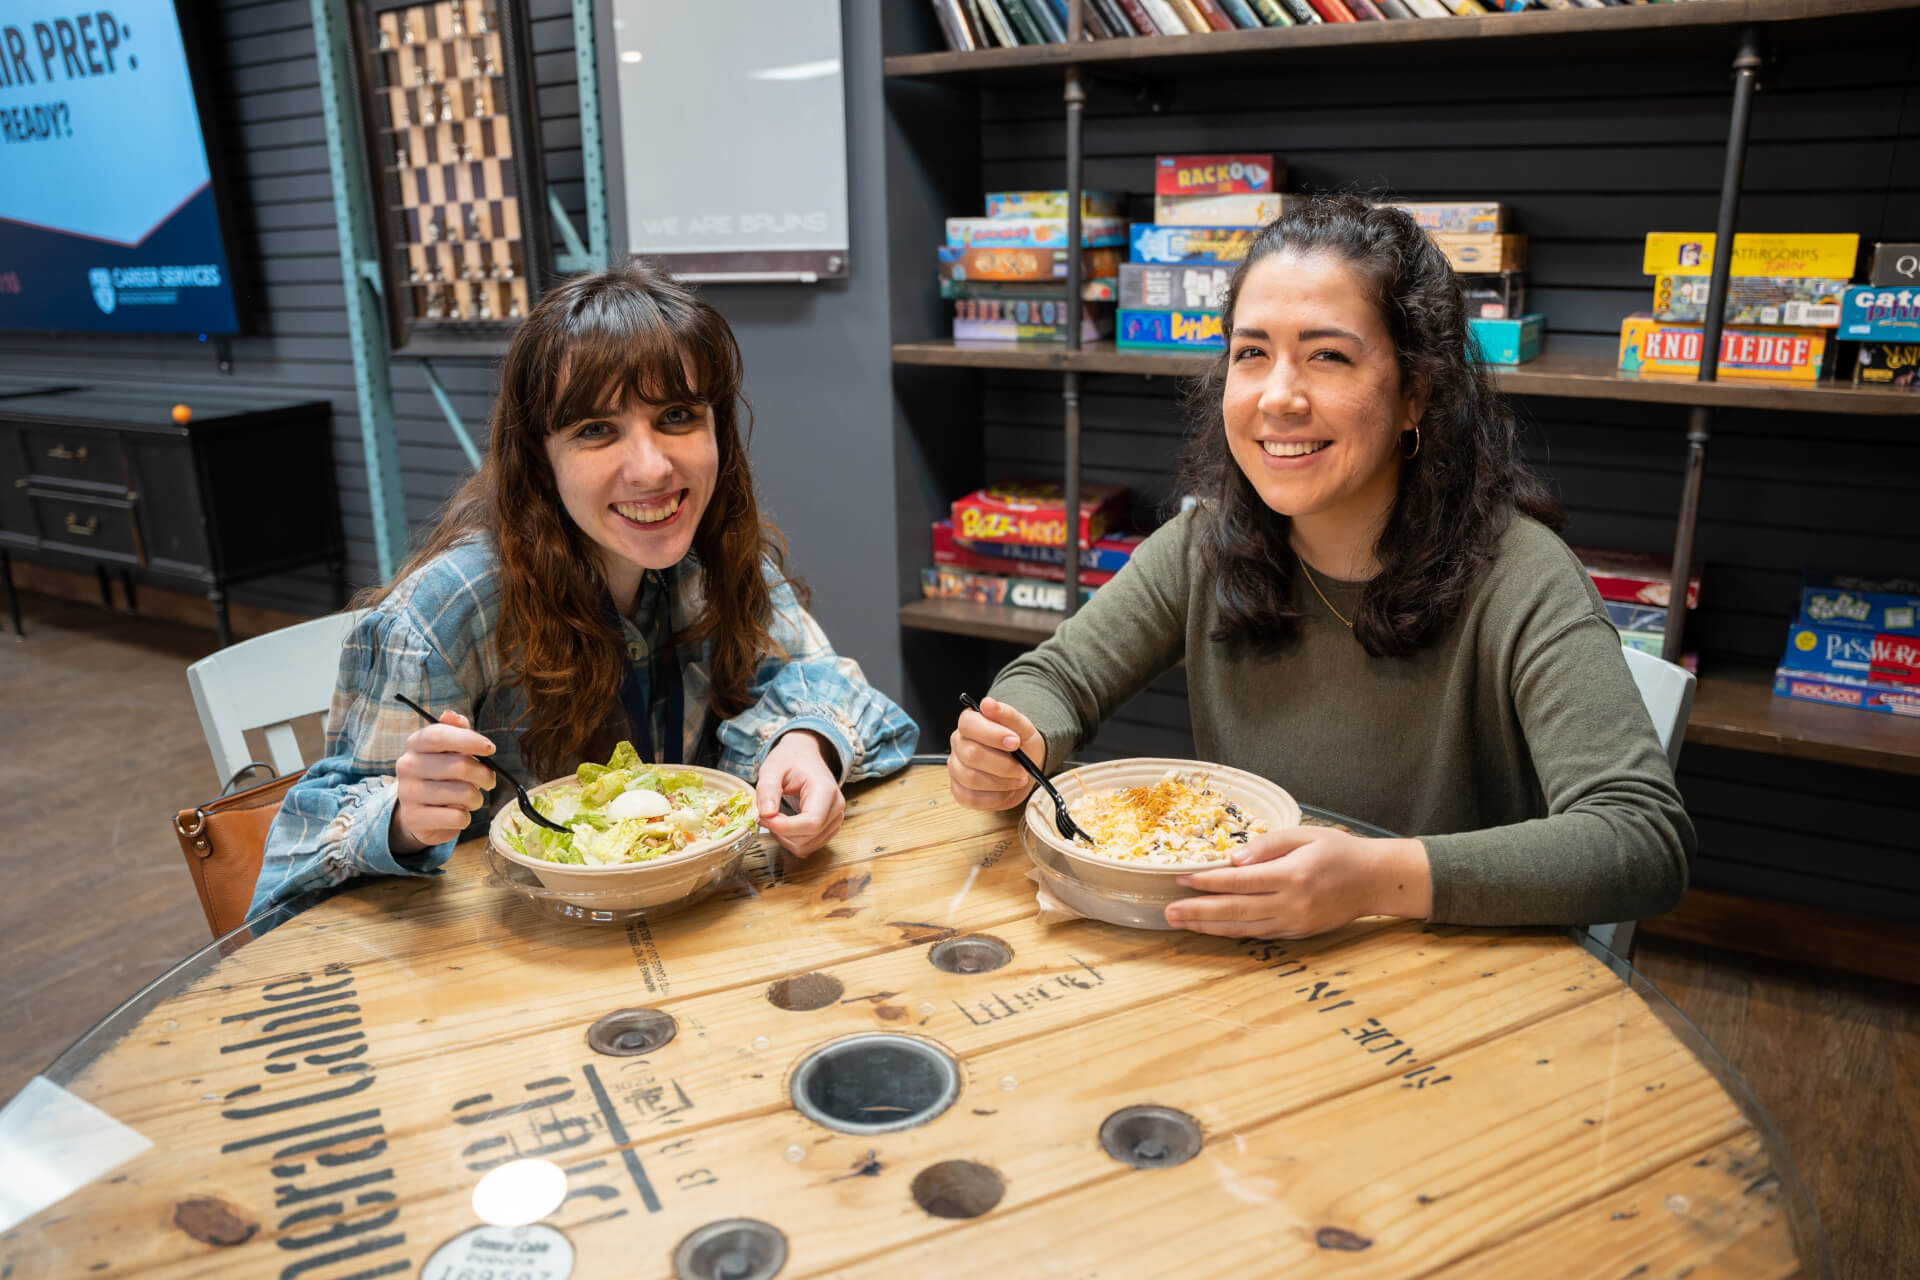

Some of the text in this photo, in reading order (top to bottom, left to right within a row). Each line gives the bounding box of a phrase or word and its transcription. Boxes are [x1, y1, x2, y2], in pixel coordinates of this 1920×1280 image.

[0, 10, 139, 88] IR PREP:
[0, 100, 73, 143] READY?
[1645, 333, 1809, 366] KNOLEDGE
